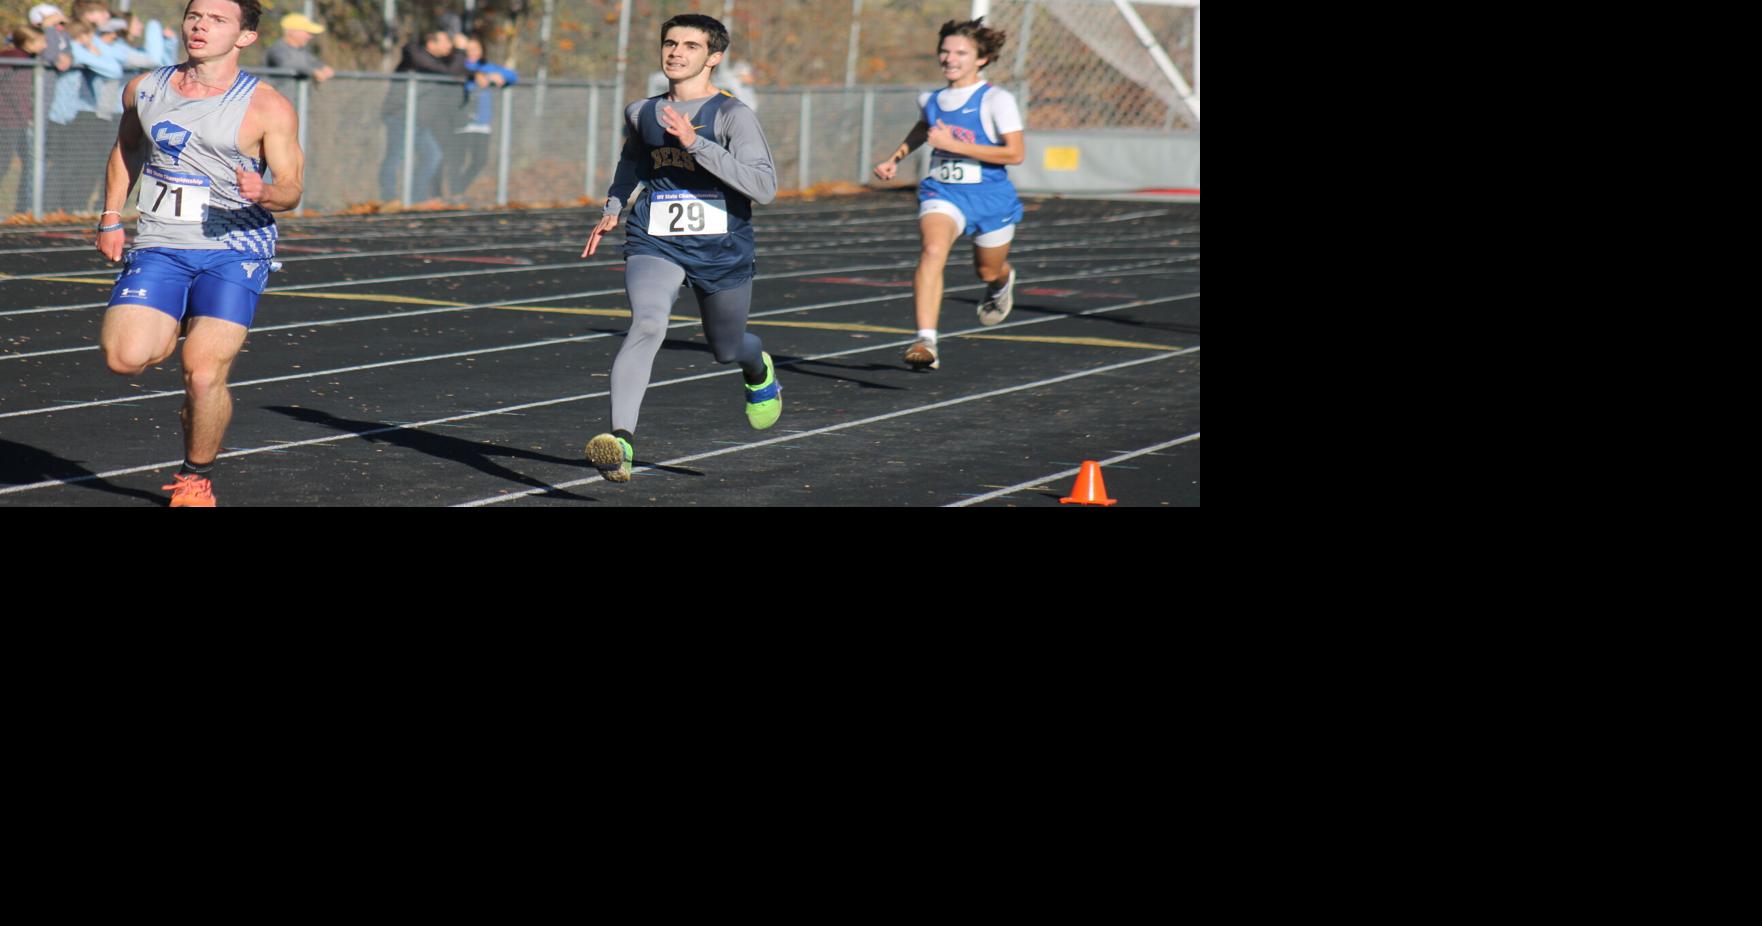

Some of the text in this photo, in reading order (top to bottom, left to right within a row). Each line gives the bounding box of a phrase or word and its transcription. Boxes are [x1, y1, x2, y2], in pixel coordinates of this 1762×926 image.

[650, 147, 695, 172] BEES
[940, 160, 963, 181] 55
[164, 174, 203, 185] Championship
[152, 181, 183, 216] 71
[669, 202, 705, 232] 29
